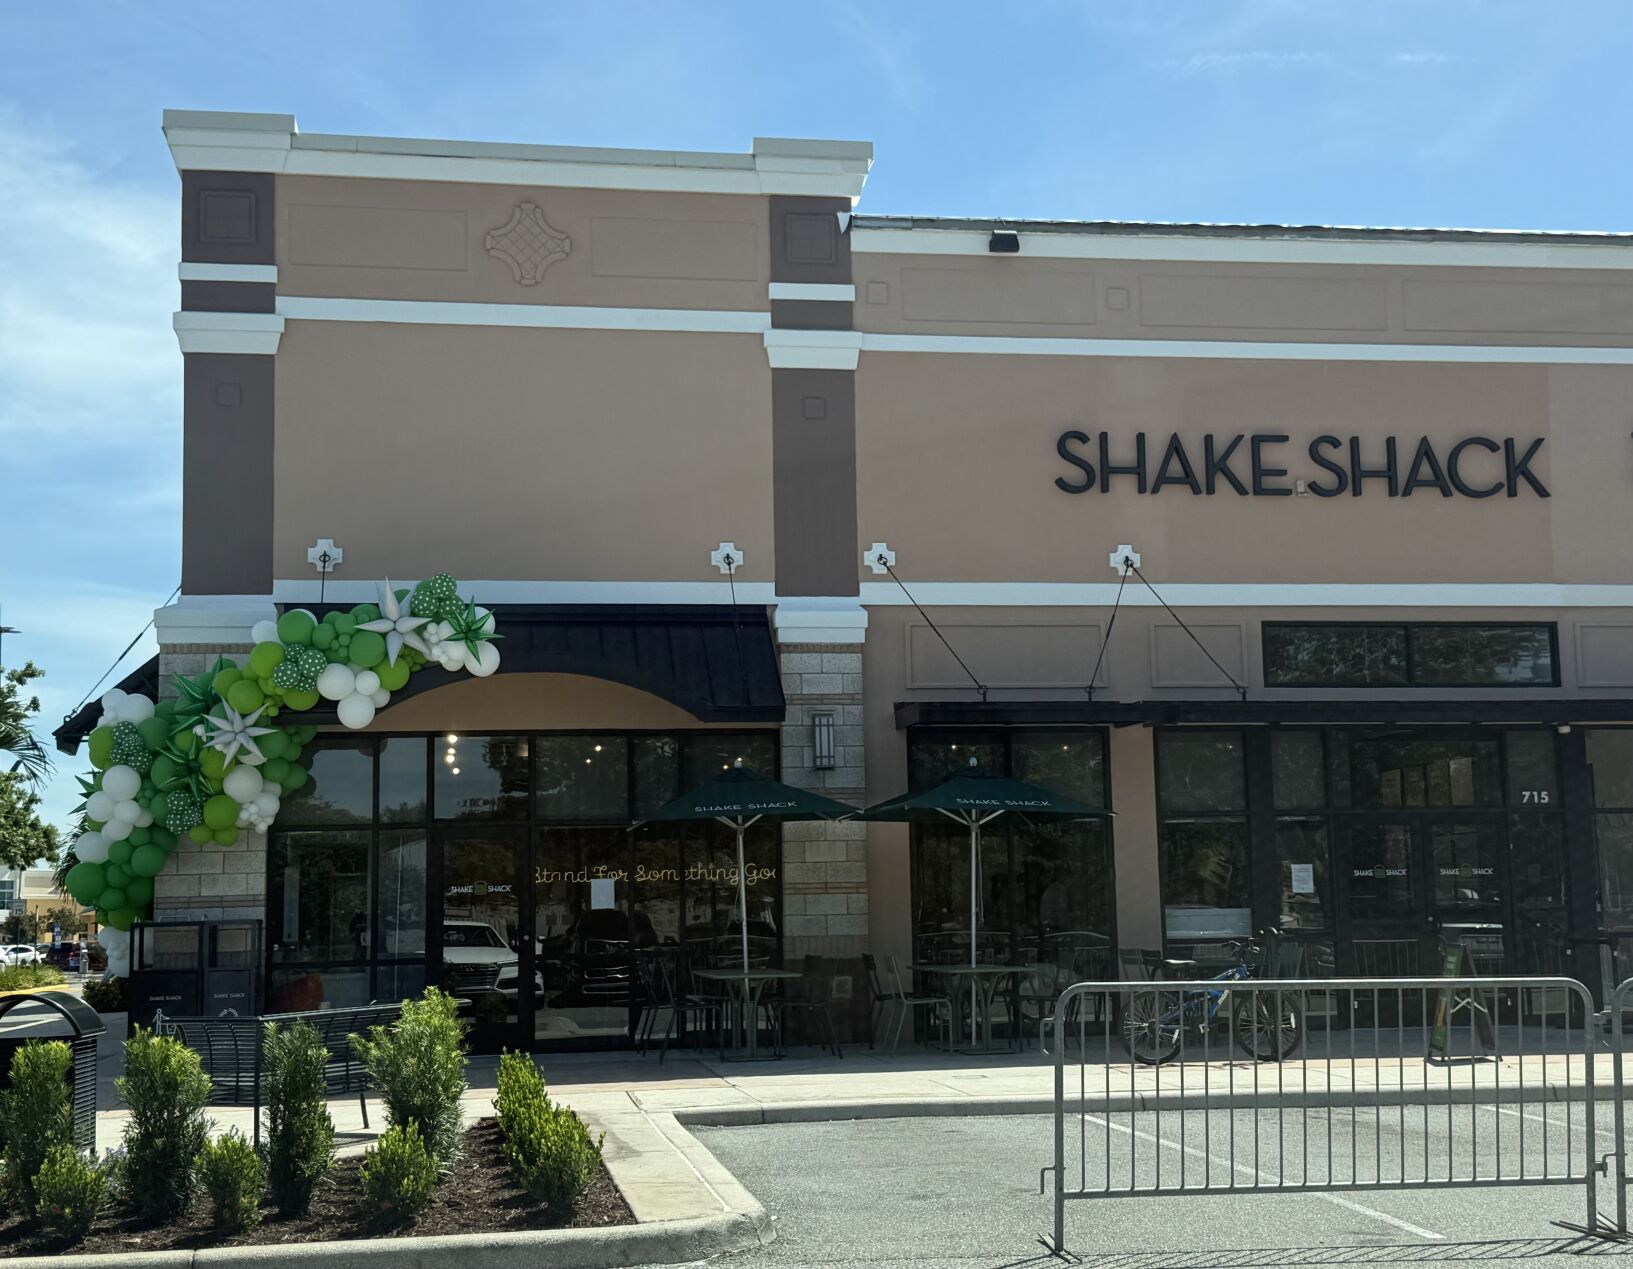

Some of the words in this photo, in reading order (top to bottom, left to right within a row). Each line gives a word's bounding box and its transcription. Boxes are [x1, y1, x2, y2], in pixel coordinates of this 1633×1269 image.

[1054, 430, 1293, 497] SHAKE
[1306, 434, 1552, 499] SHACK
[1521, 791, 1549, 804] 715
[694, 804, 742, 812] SHAKE
[748, 801, 798, 809] SHACK
[593, 865, 629, 882] For
[634, 864, 739, 886] Somthing
[1353, 869, 1374, 877] SHAKE
[1385, 868, 1407, 876] SHACK
[1439, 868, 1460, 876] SHAKE
[1471, 867, 1494, 875] SHACK
[450, 885, 474, 893] SHAKE
[487, 884, 512, 893] SHACK
